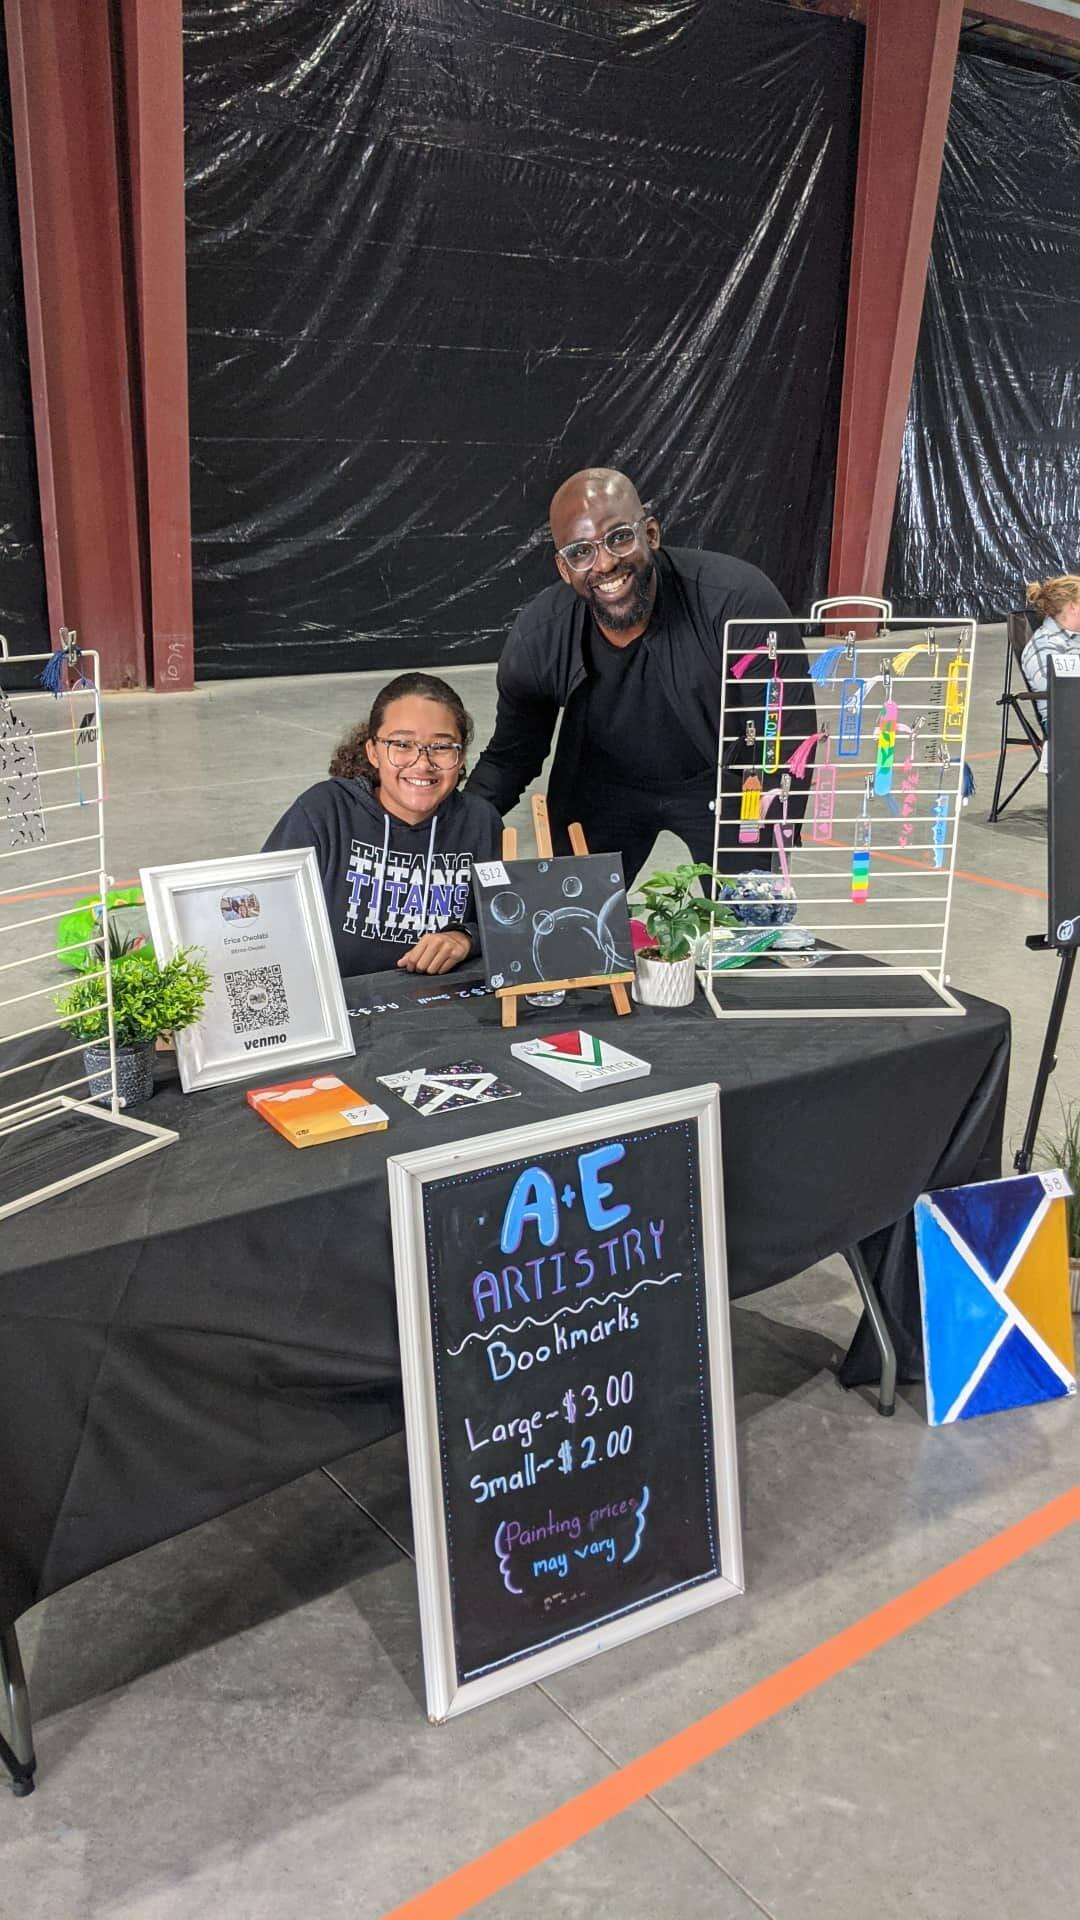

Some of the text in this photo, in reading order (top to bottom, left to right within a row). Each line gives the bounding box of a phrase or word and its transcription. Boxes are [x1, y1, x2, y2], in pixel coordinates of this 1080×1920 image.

[1054, 657, 1076, 672] $17
[479, 866, 503, 882] $12
[346, 869, 470, 918] TITANS
[243, 1032, 287, 1051] venmo
[575, 1059, 639, 1080] SUMMER
[1043, 1176, 1063, 1193] $8
[472, 1218, 666, 1322] ARTISTRY
[486, 1302, 640, 1382] Bookmarks
[505, 1497, 639, 1552] Painting prices
[532, 1537, 617, 1578] may vary
